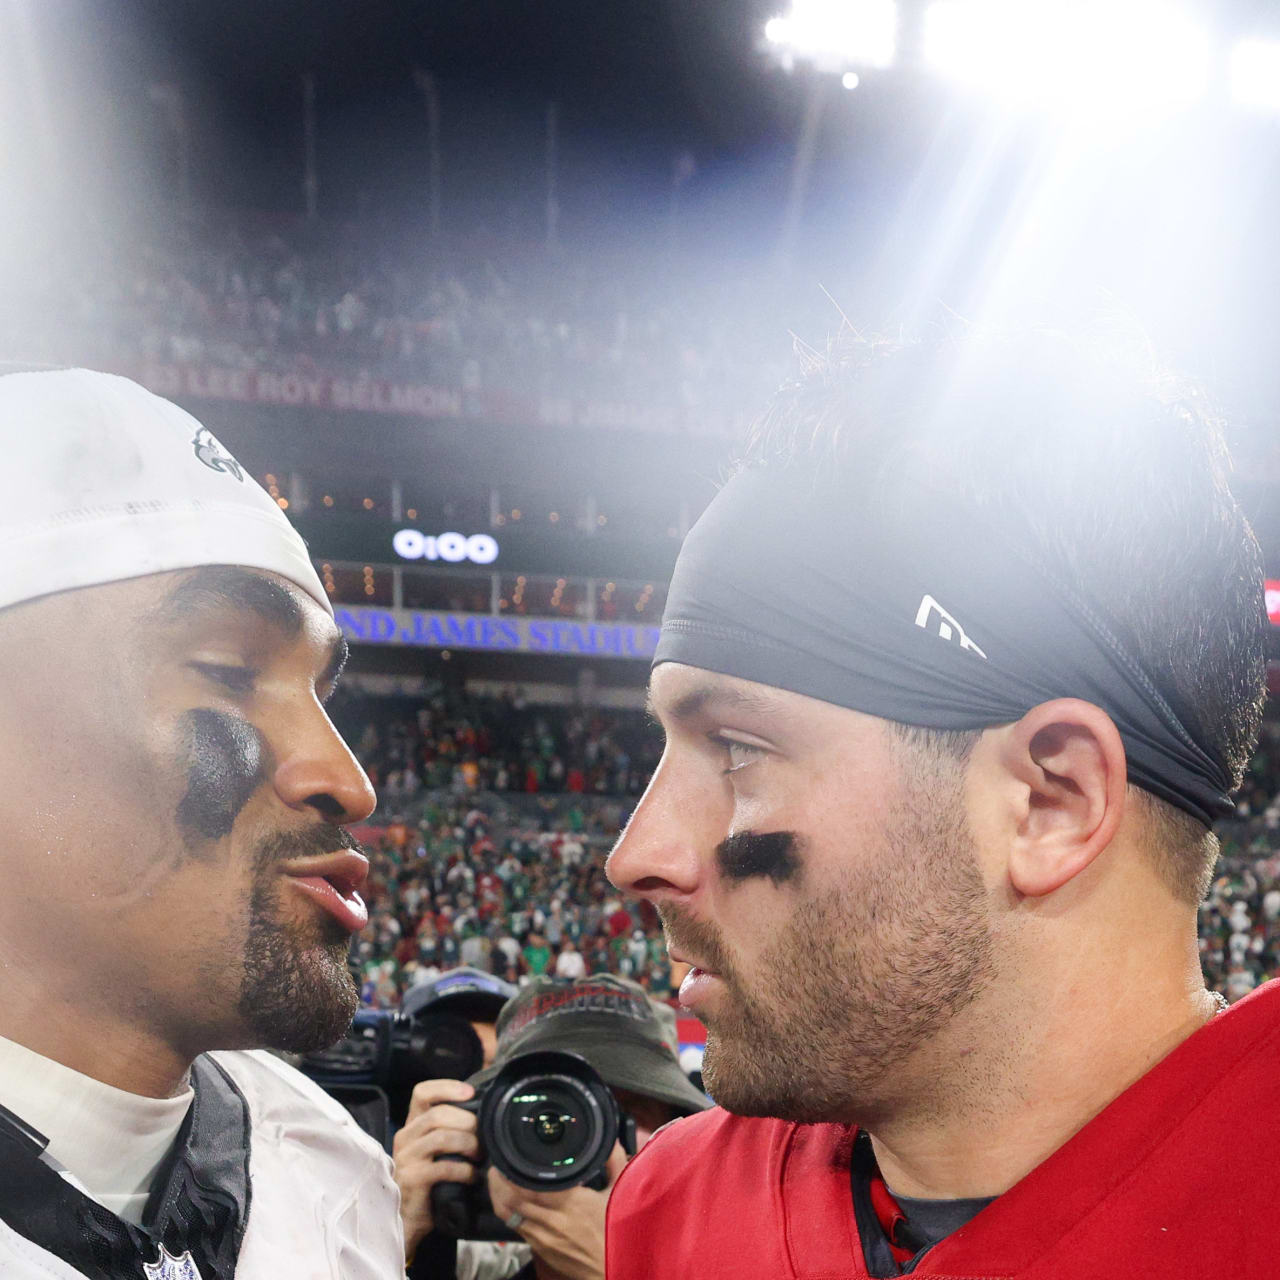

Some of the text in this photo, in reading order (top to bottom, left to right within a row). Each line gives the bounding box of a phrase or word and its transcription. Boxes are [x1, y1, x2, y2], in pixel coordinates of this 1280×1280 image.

[257, 373, 324, 405] ROY
[393, 529, 499, 564] 0:00
[401, 611, 519, 649] JAMES
[528, 619, 660, 658] STADIU
